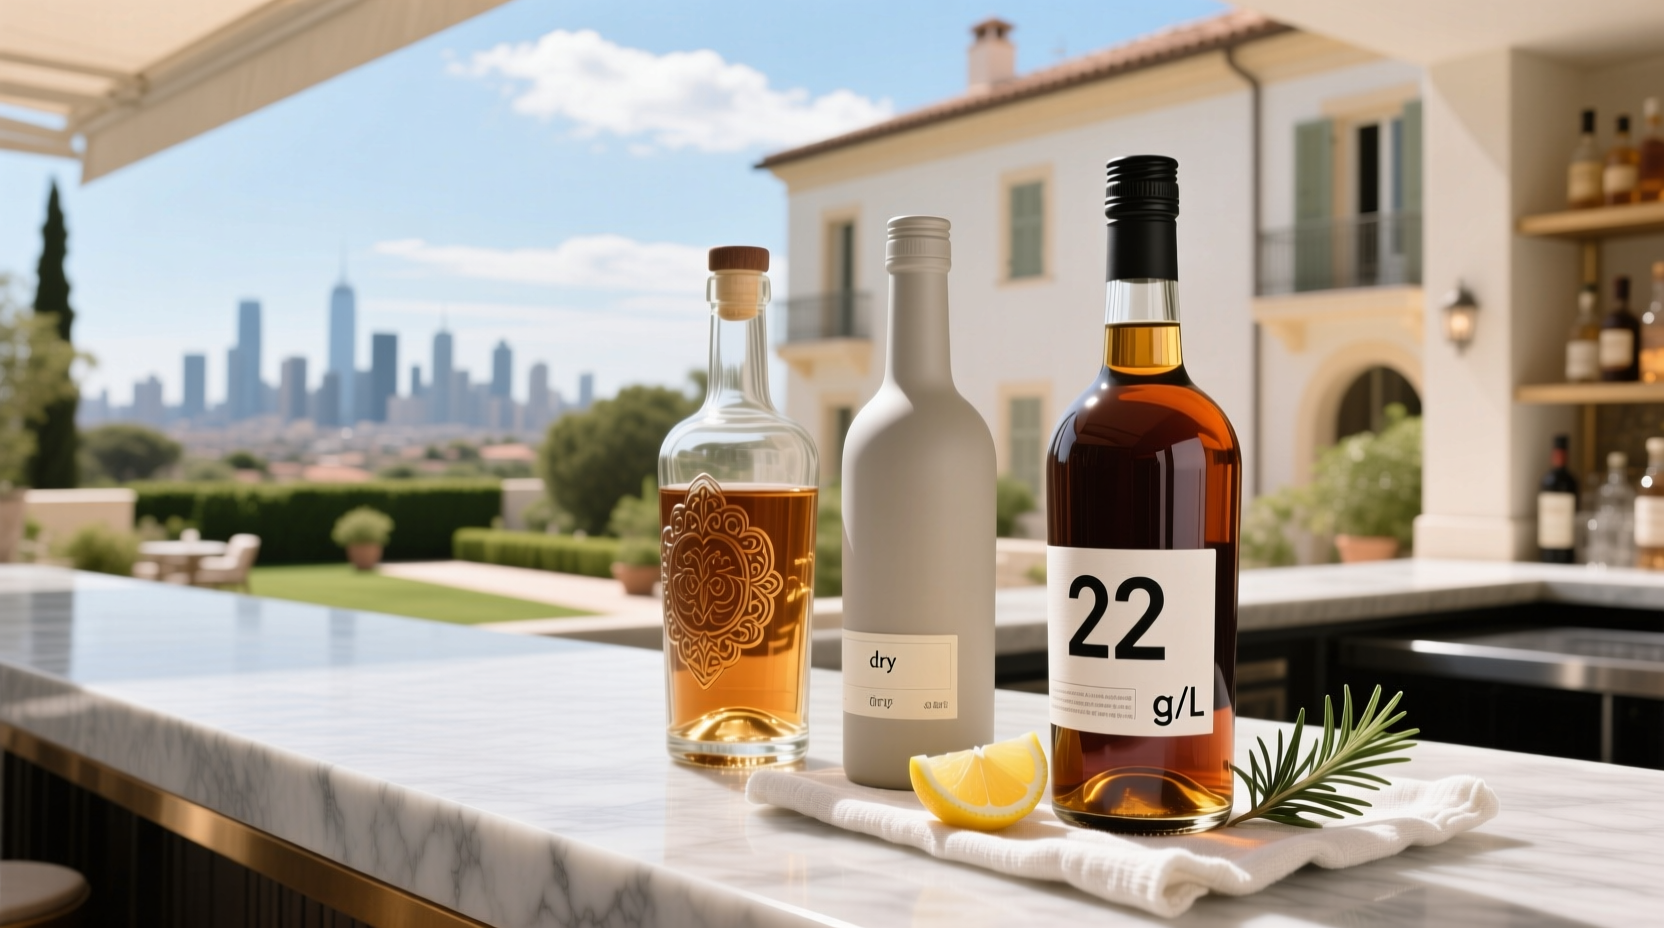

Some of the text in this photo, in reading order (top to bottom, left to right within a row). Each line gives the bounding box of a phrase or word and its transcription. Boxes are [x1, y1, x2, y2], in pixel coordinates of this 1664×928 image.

[1069, 575, 1165, 660] 22
[869, 649, 897, 674] dry
[1153, 685, 1205, 727] g/L
